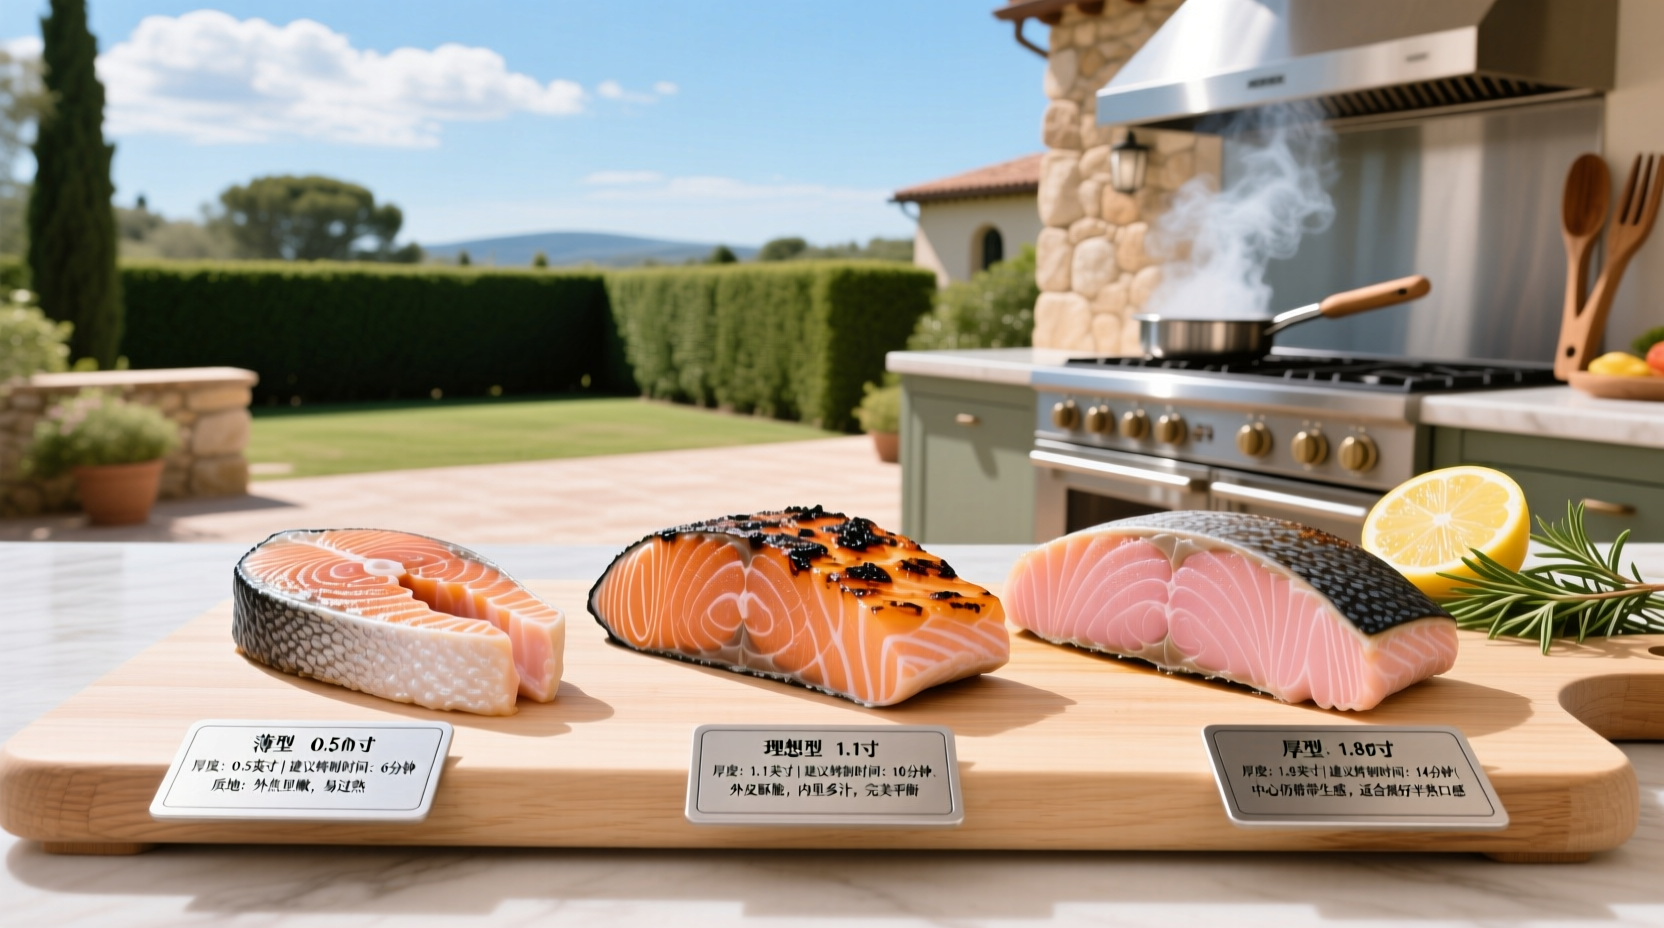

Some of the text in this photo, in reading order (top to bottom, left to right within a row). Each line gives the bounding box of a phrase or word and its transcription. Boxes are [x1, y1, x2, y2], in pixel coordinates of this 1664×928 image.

[763, 738, 879, 758] 理想型 1.1寸
